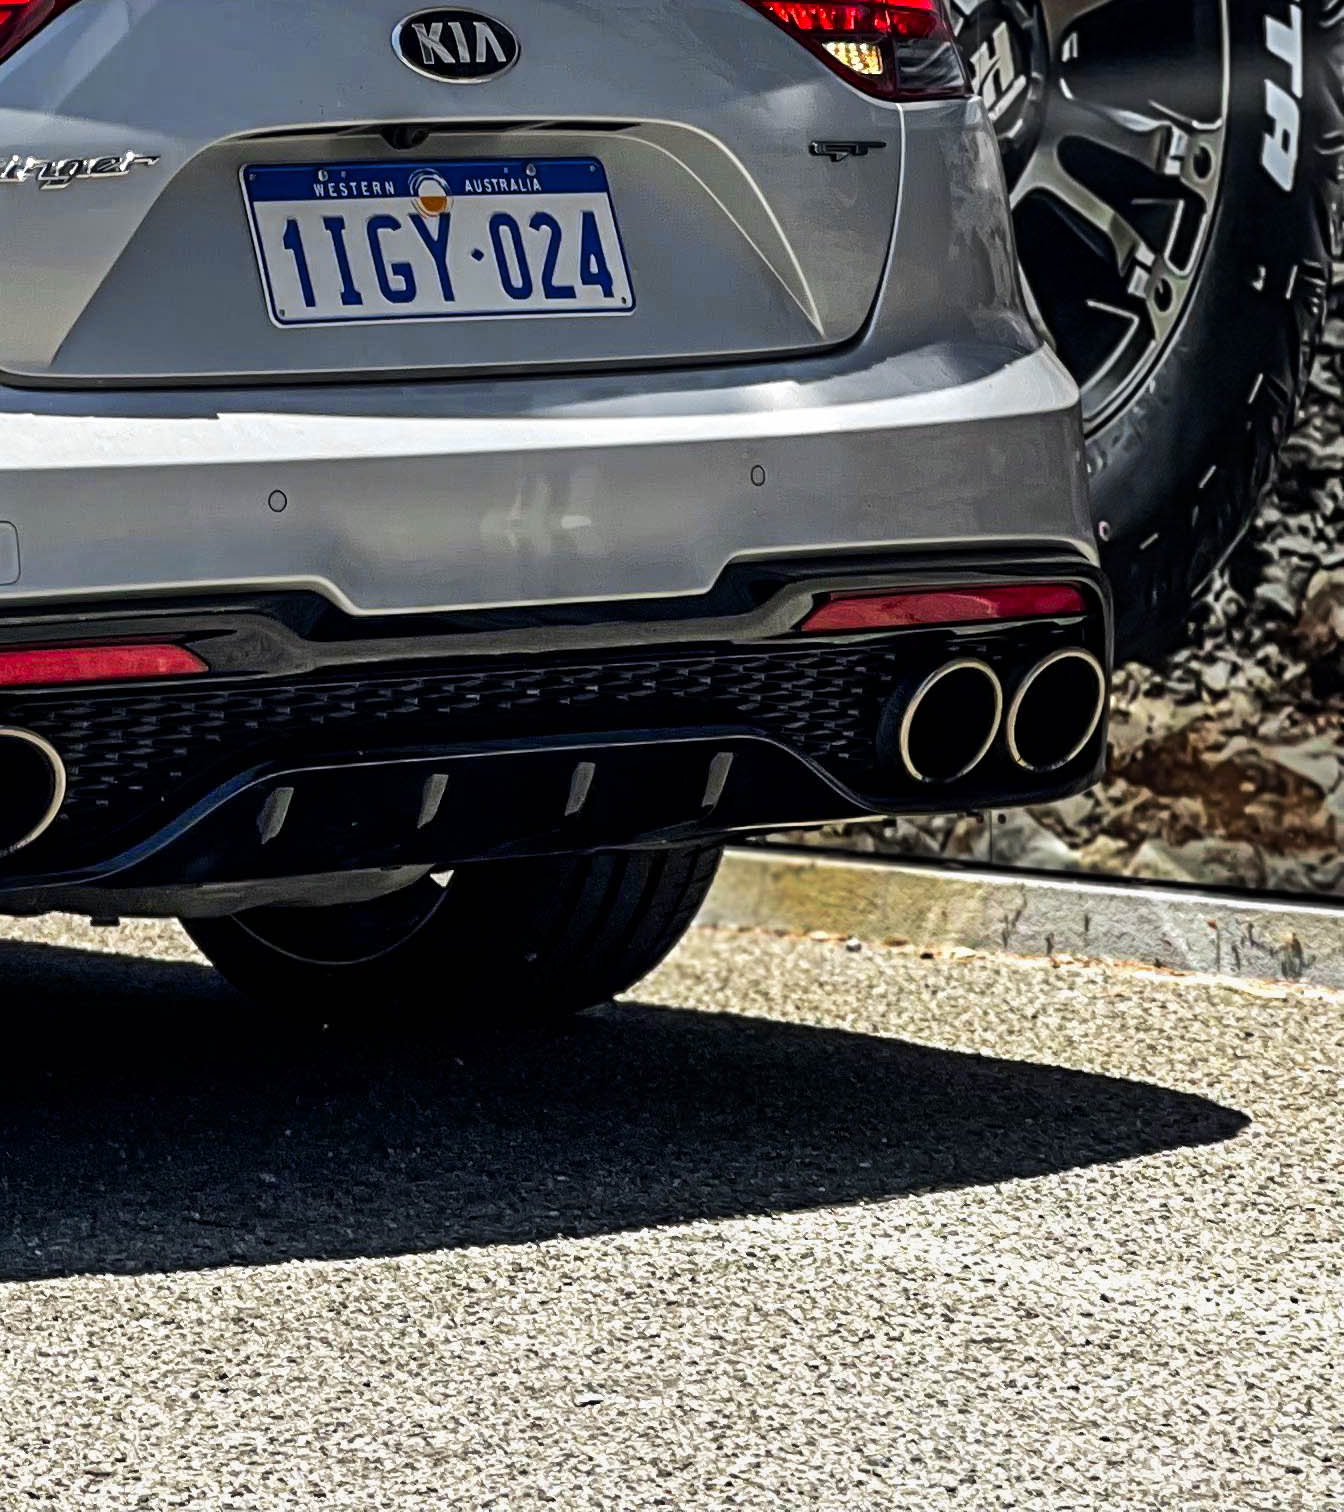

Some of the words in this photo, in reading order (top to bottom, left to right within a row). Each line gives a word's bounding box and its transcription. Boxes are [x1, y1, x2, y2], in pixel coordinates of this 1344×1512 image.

[411, 20, 508, 65] KIA
[312, 180, 396, 199] WESTERN
[464, 177, 544, 194] AUSTRALIA
